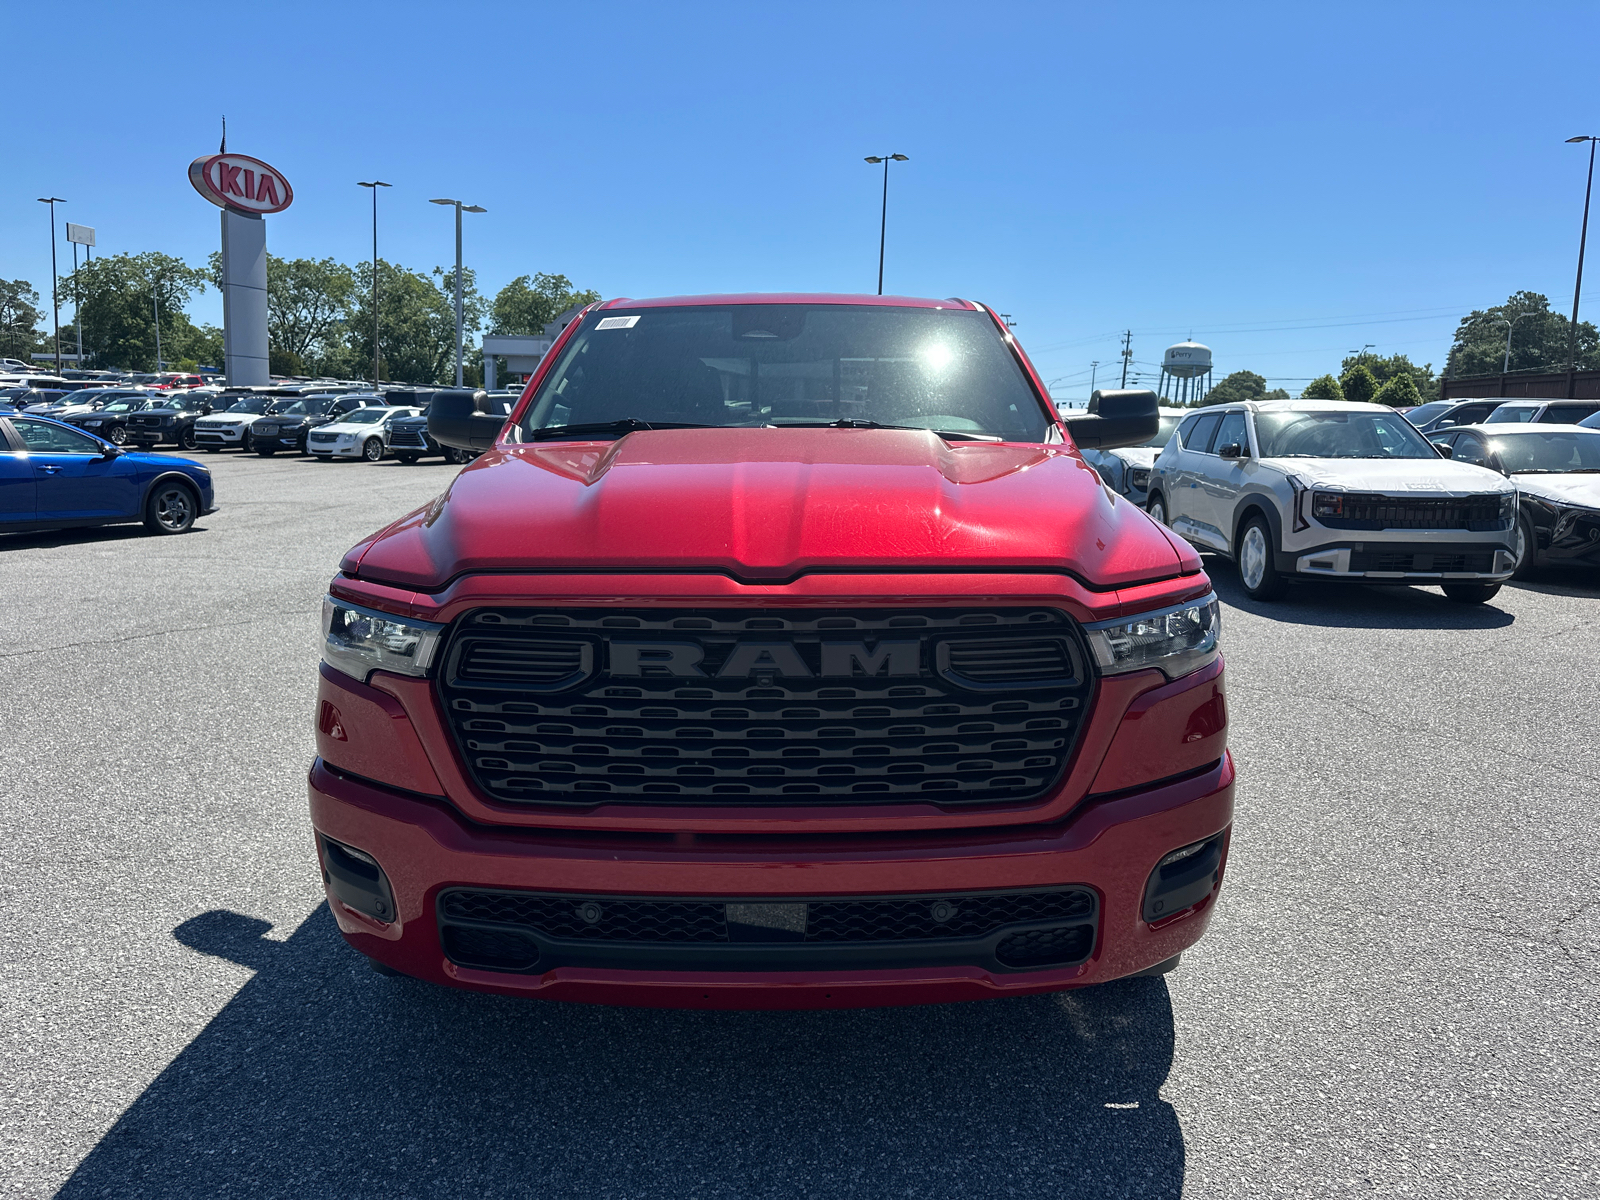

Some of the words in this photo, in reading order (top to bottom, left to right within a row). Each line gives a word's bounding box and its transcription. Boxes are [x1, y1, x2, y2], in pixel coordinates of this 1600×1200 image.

[218, 161, 280, 206] KIA
[1175, 351, 1192, 359] Perry
[609, 637, 922, 678] RAM
